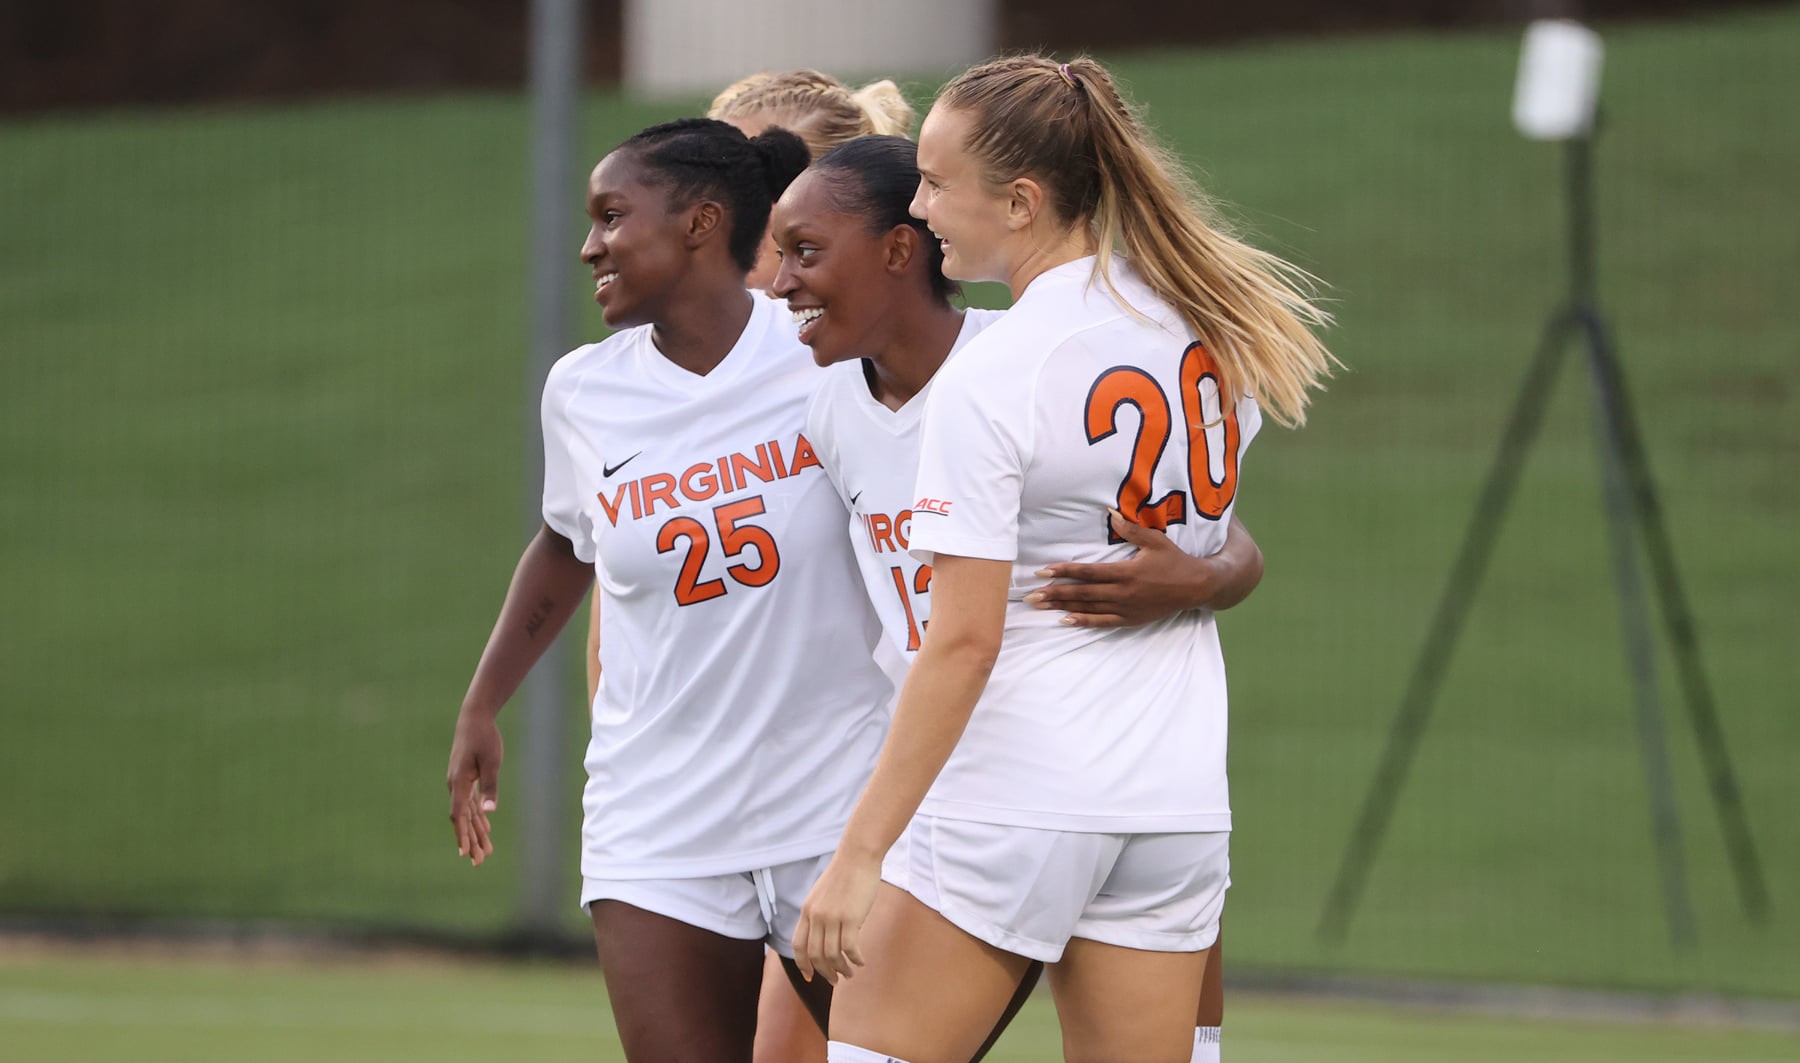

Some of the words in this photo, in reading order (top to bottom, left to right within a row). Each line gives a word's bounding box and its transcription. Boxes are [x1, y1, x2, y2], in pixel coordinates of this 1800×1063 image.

[597, 433, 825, 528] VIRGINIA
[1083, 340, 1241, 545] 20
[656, 494, 781, 607] 25
[914, 497, 953, 514] ACC
